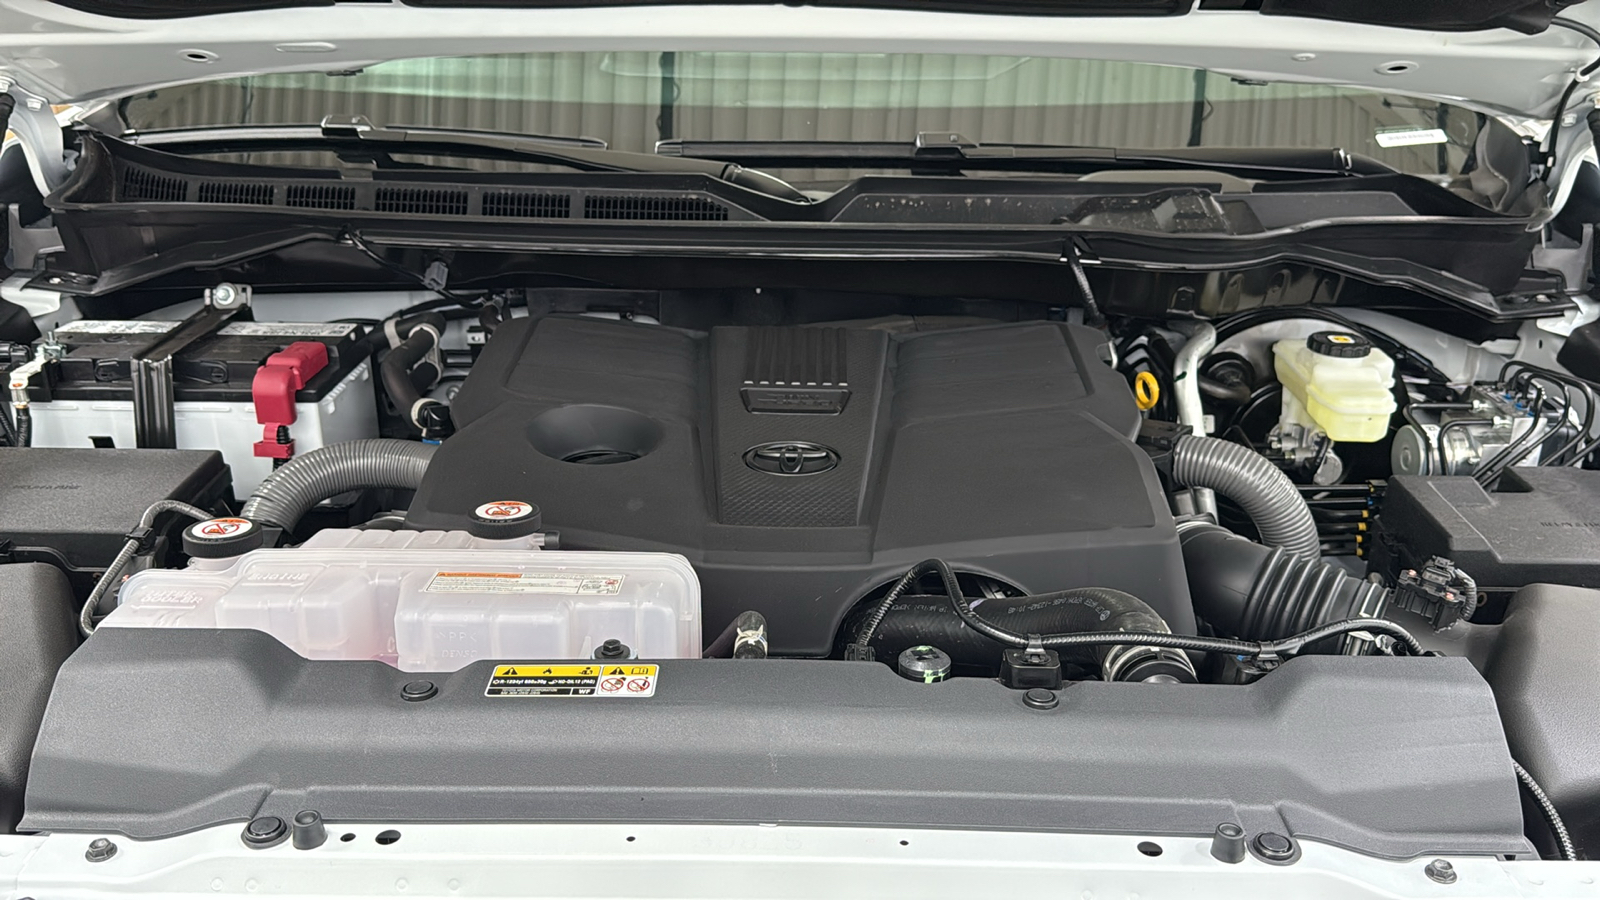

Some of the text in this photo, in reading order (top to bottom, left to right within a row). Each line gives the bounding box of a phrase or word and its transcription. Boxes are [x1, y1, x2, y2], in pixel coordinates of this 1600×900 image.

[247, 572, 310, 580] ENGINE
[141, 596, 203, 604] COOLER
[441, 649, 478, 658] DENSO
